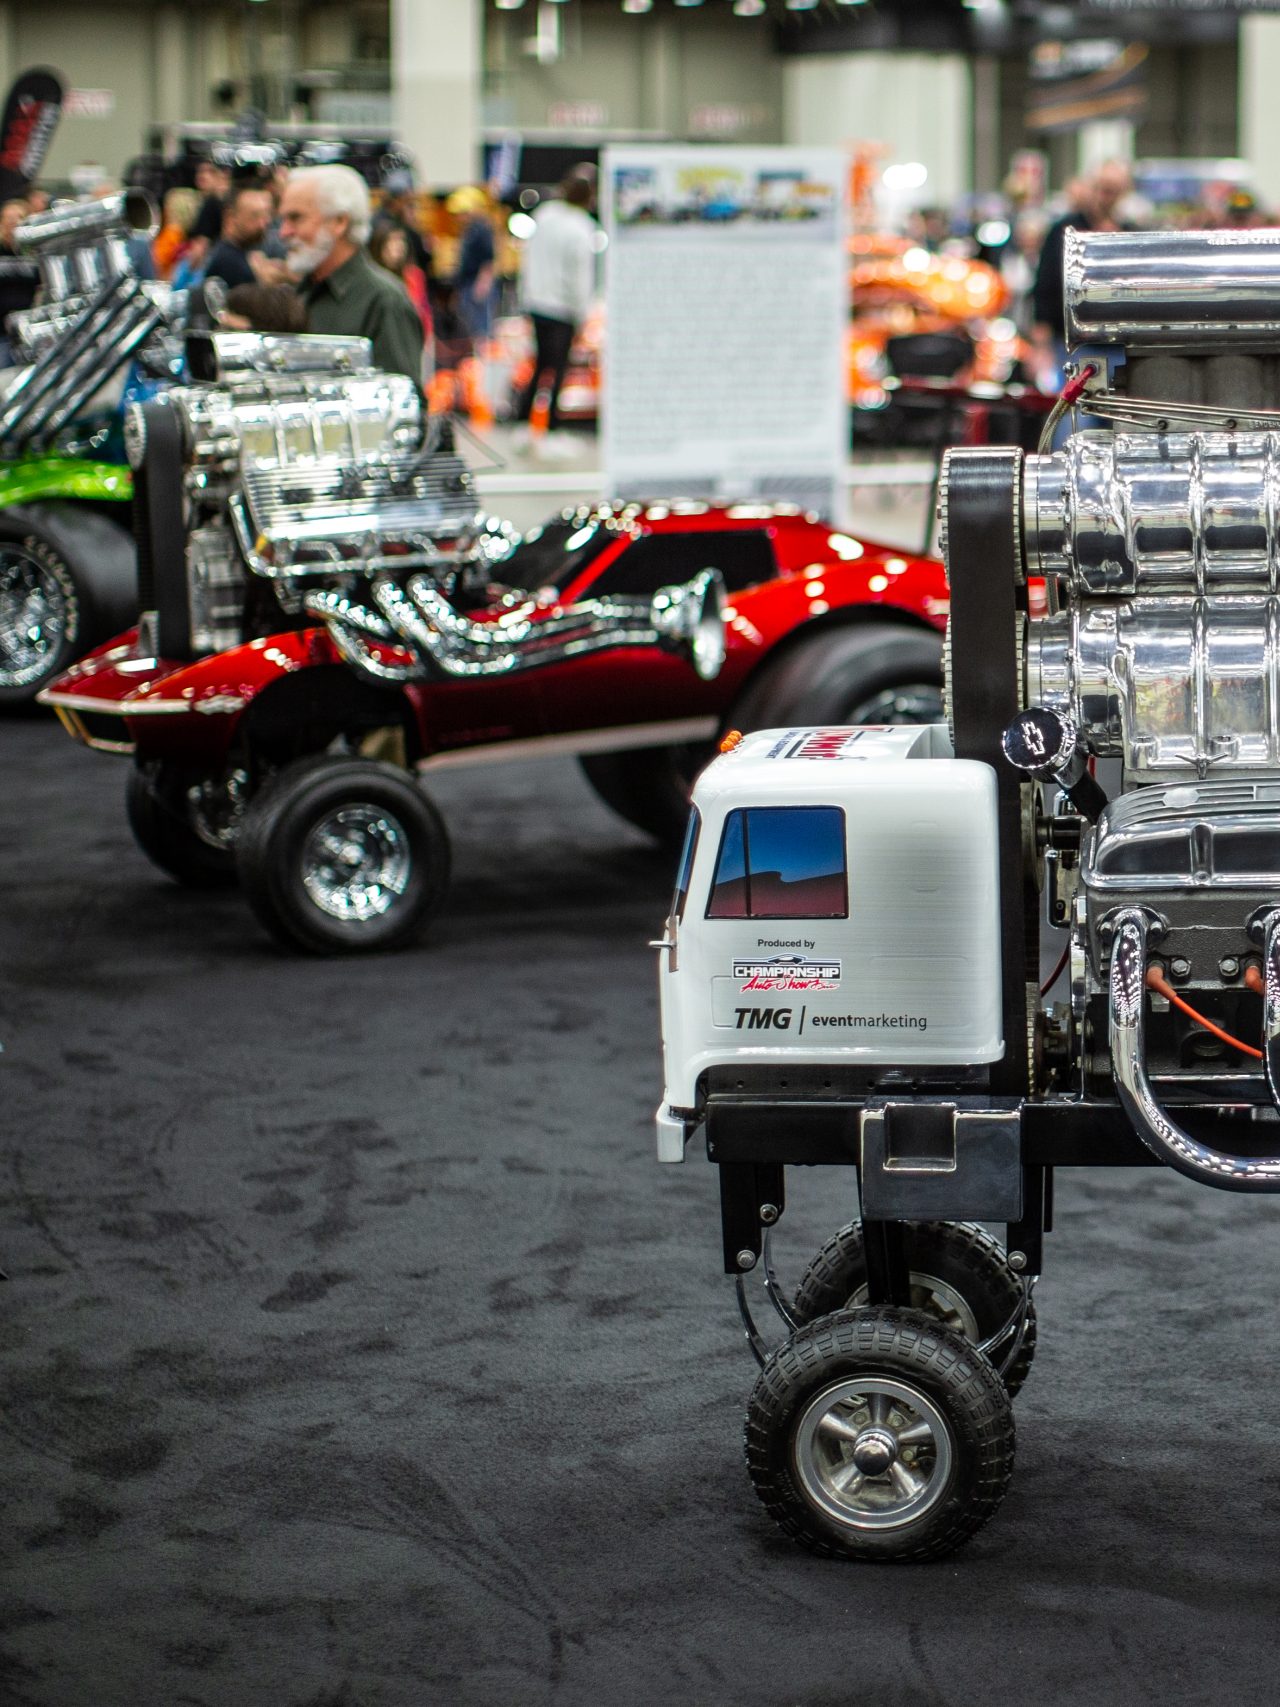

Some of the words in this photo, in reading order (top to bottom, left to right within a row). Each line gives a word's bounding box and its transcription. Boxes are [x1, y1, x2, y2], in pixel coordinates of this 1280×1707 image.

[757, 938, 802, 948] Produced
[803, 938, 816, 950] by
[734, 965, 840, 978] CHAMPIONSHIP
[740, 974, 780, 993] Auto
[734, 1007, 793, 1030] TMG
[811, 1013, 928, 1032] eventmarketing
